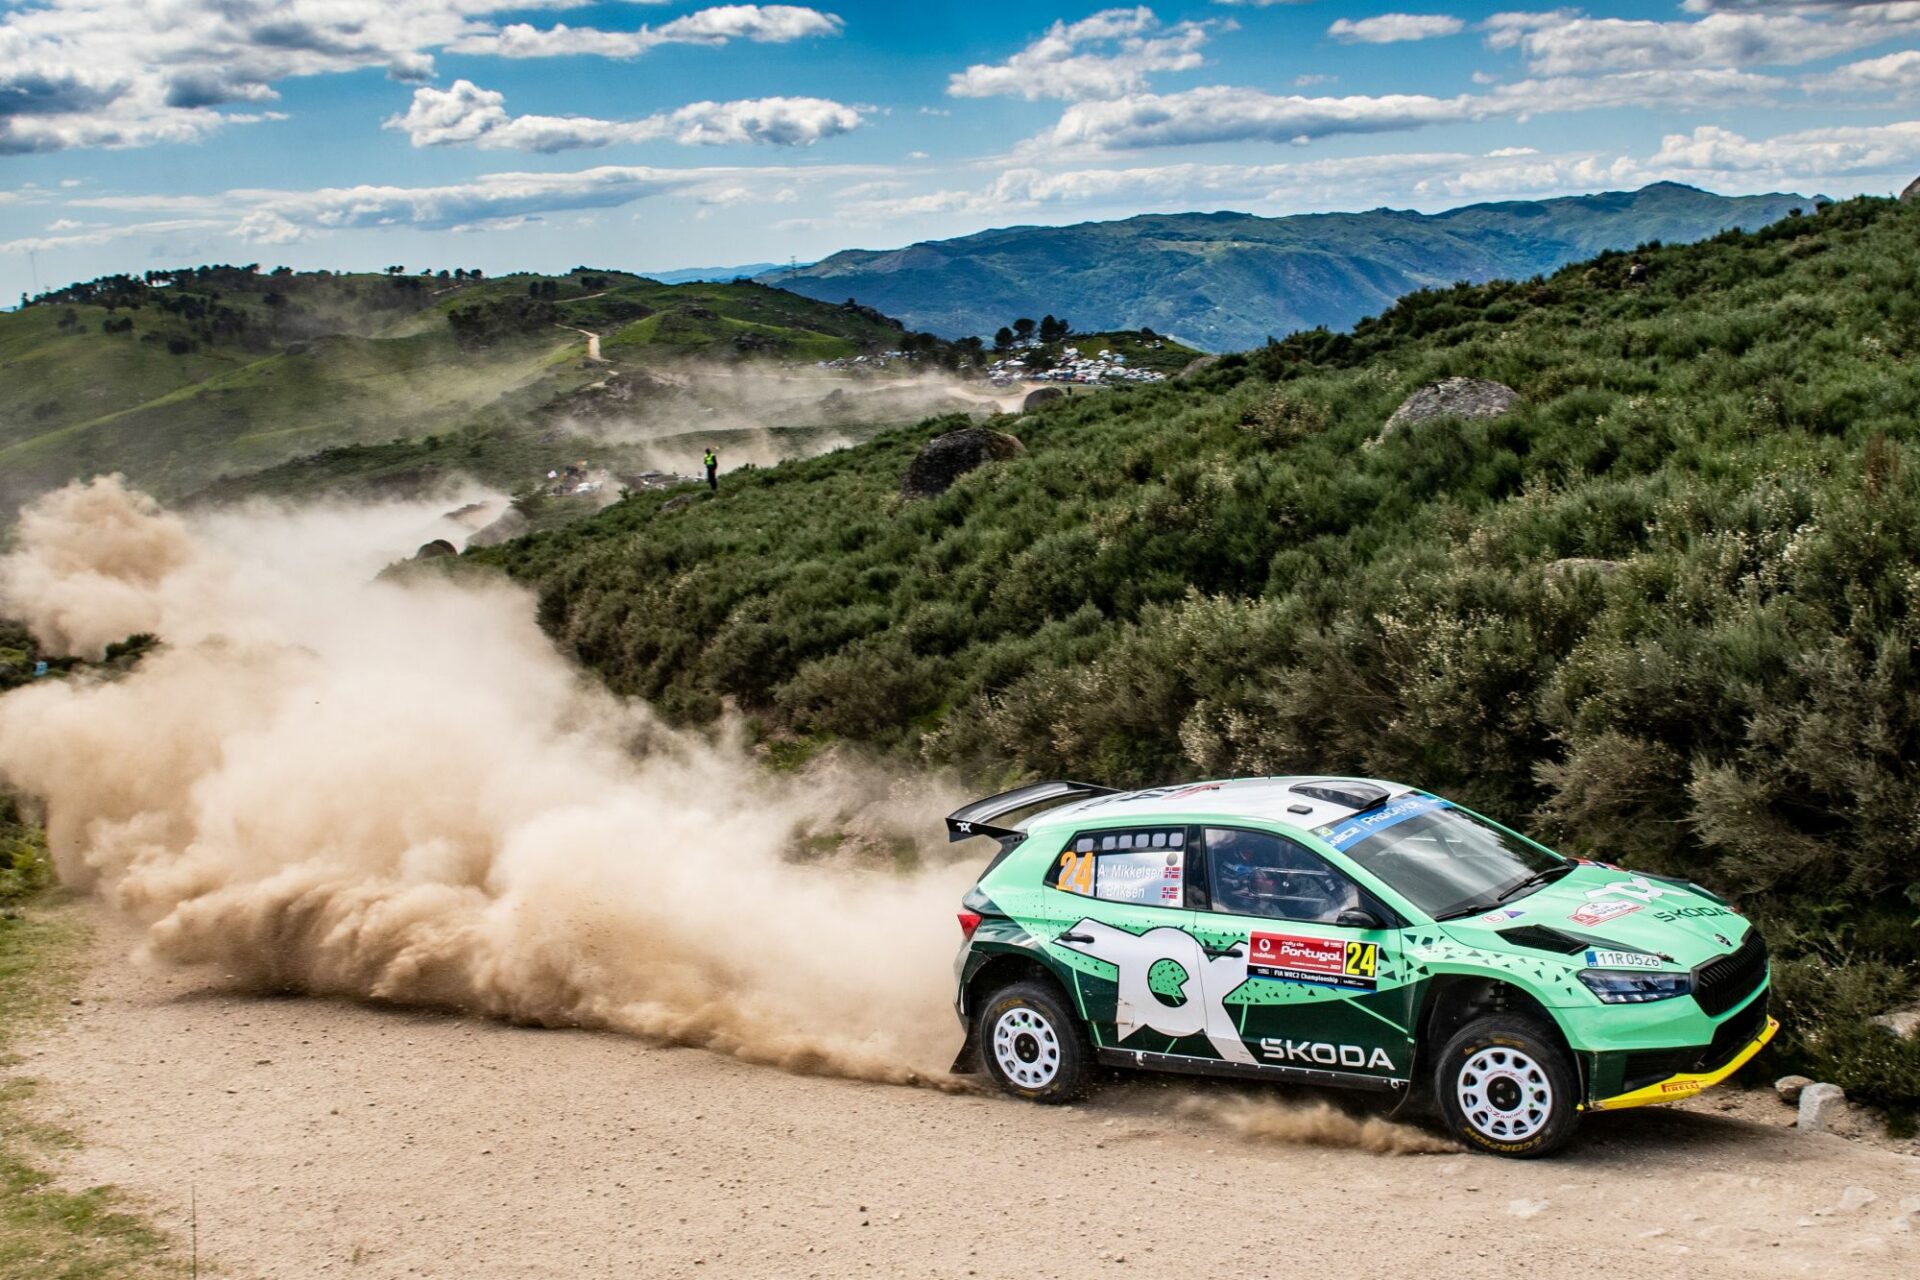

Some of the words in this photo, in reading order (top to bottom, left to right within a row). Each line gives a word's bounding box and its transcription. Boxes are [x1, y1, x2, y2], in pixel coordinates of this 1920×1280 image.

[1056, 851, 1094, 893] 24
[1281, 945, 1342, 961] Portugal
[1345, 942, 1376, 977] 24
[1661, 1080, 1700, 1093] PIRELLI
